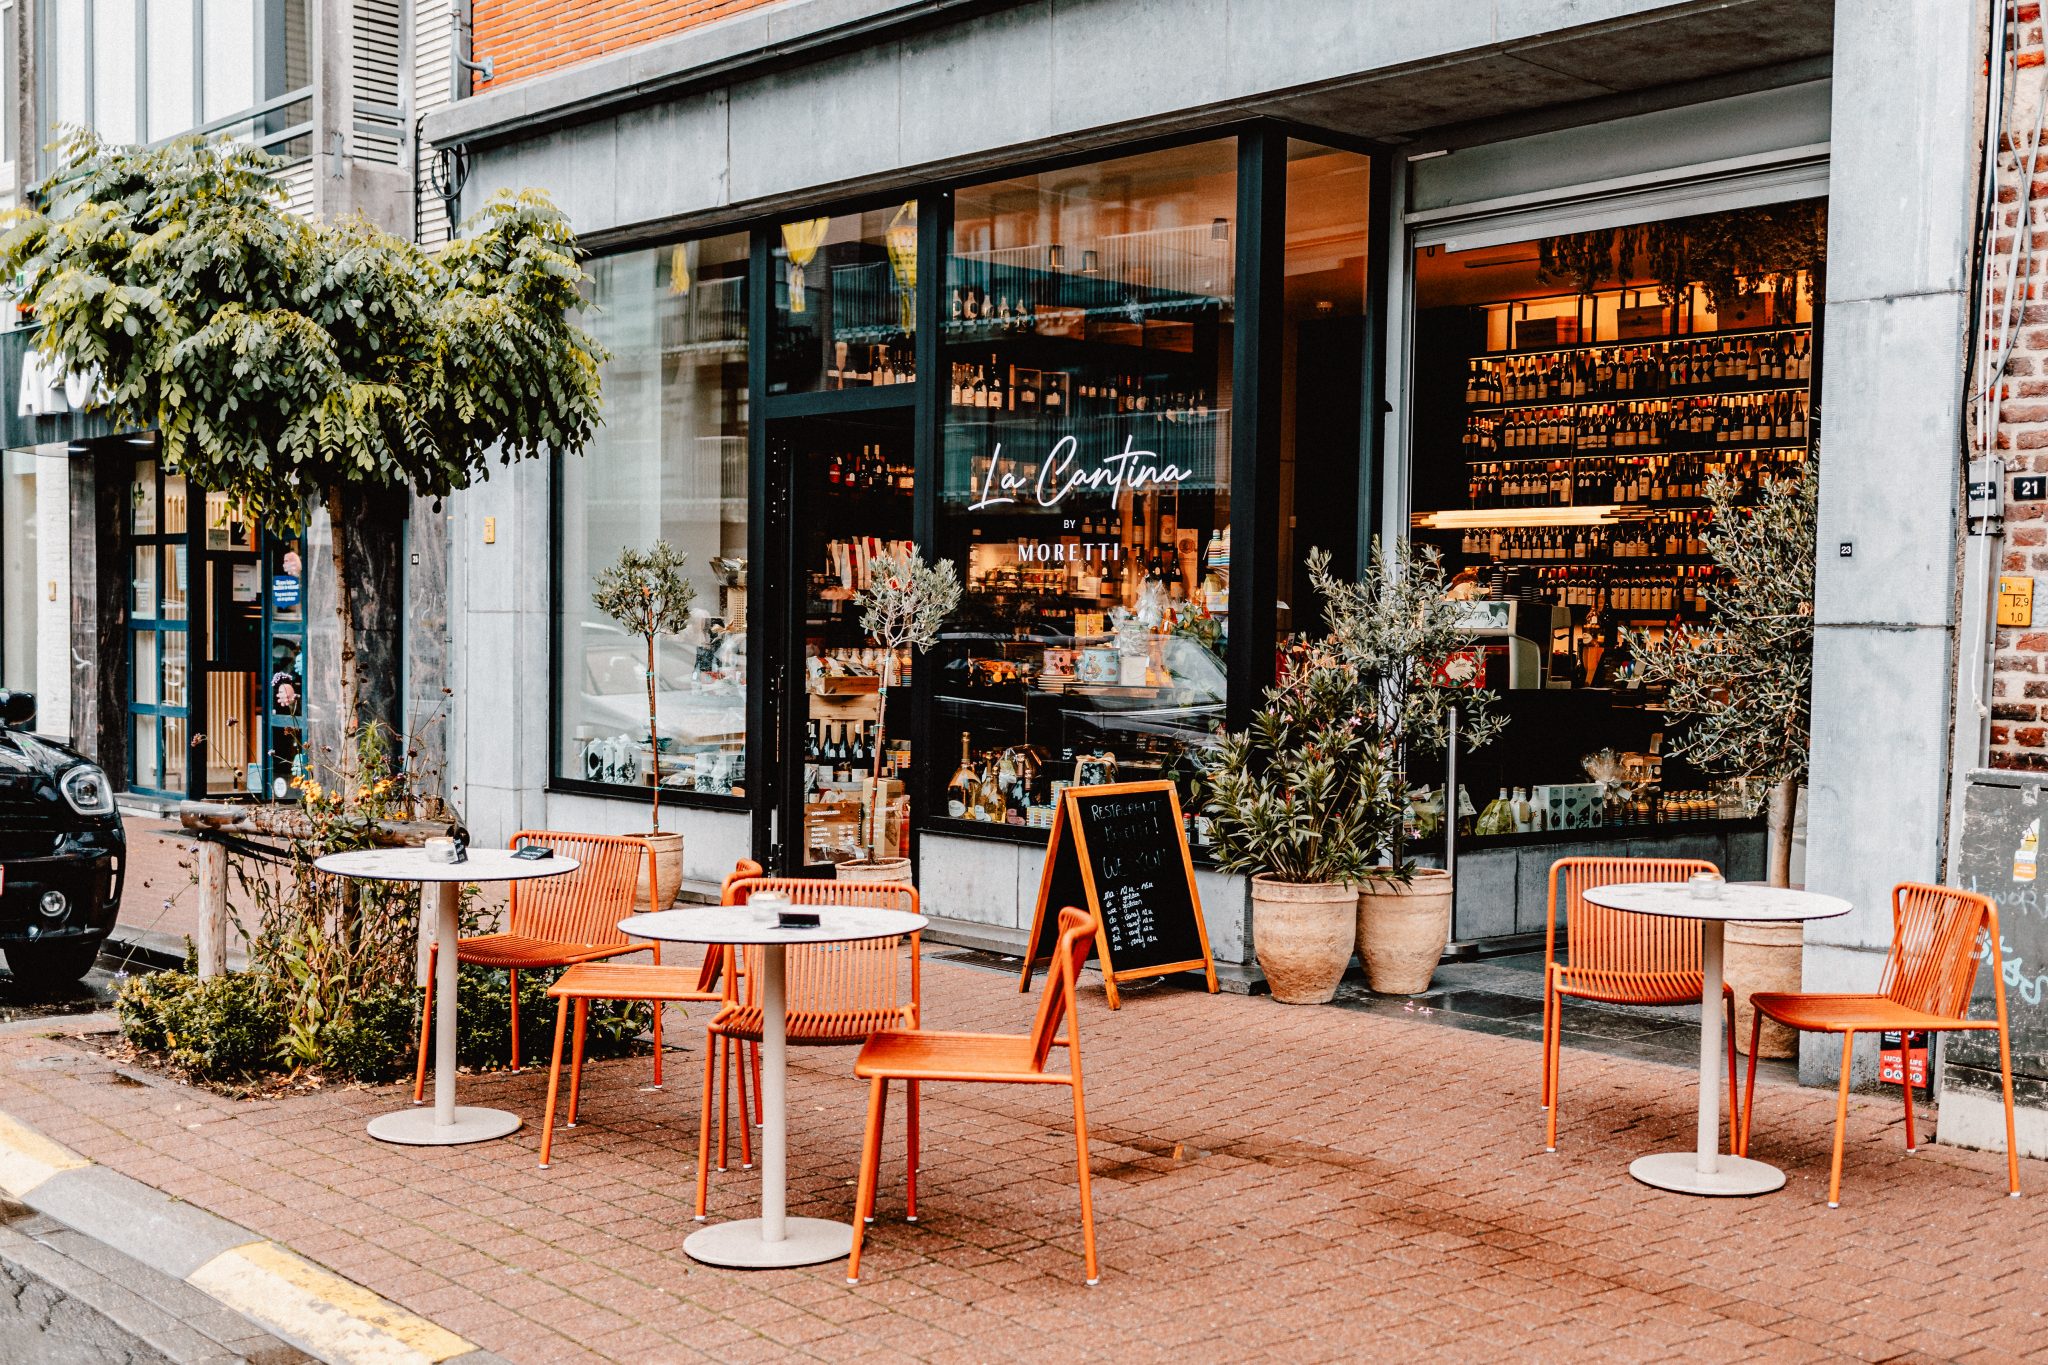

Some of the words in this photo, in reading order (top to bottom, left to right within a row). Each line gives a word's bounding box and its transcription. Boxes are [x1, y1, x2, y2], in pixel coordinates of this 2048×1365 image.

[967, 442, 1027, 512] La
[1036, 434, 1193, 510] Cantina
[2022, 480, 2038, 495] 21
[1063, 519, 1076, 529] BY
[1017, 542, 1120, 562] MORETTI
[1841, 546, 1852, 555] 23
[2015, 597, 2030, 608] 2,9
[2010, 612, 2024, 623] 1,0
